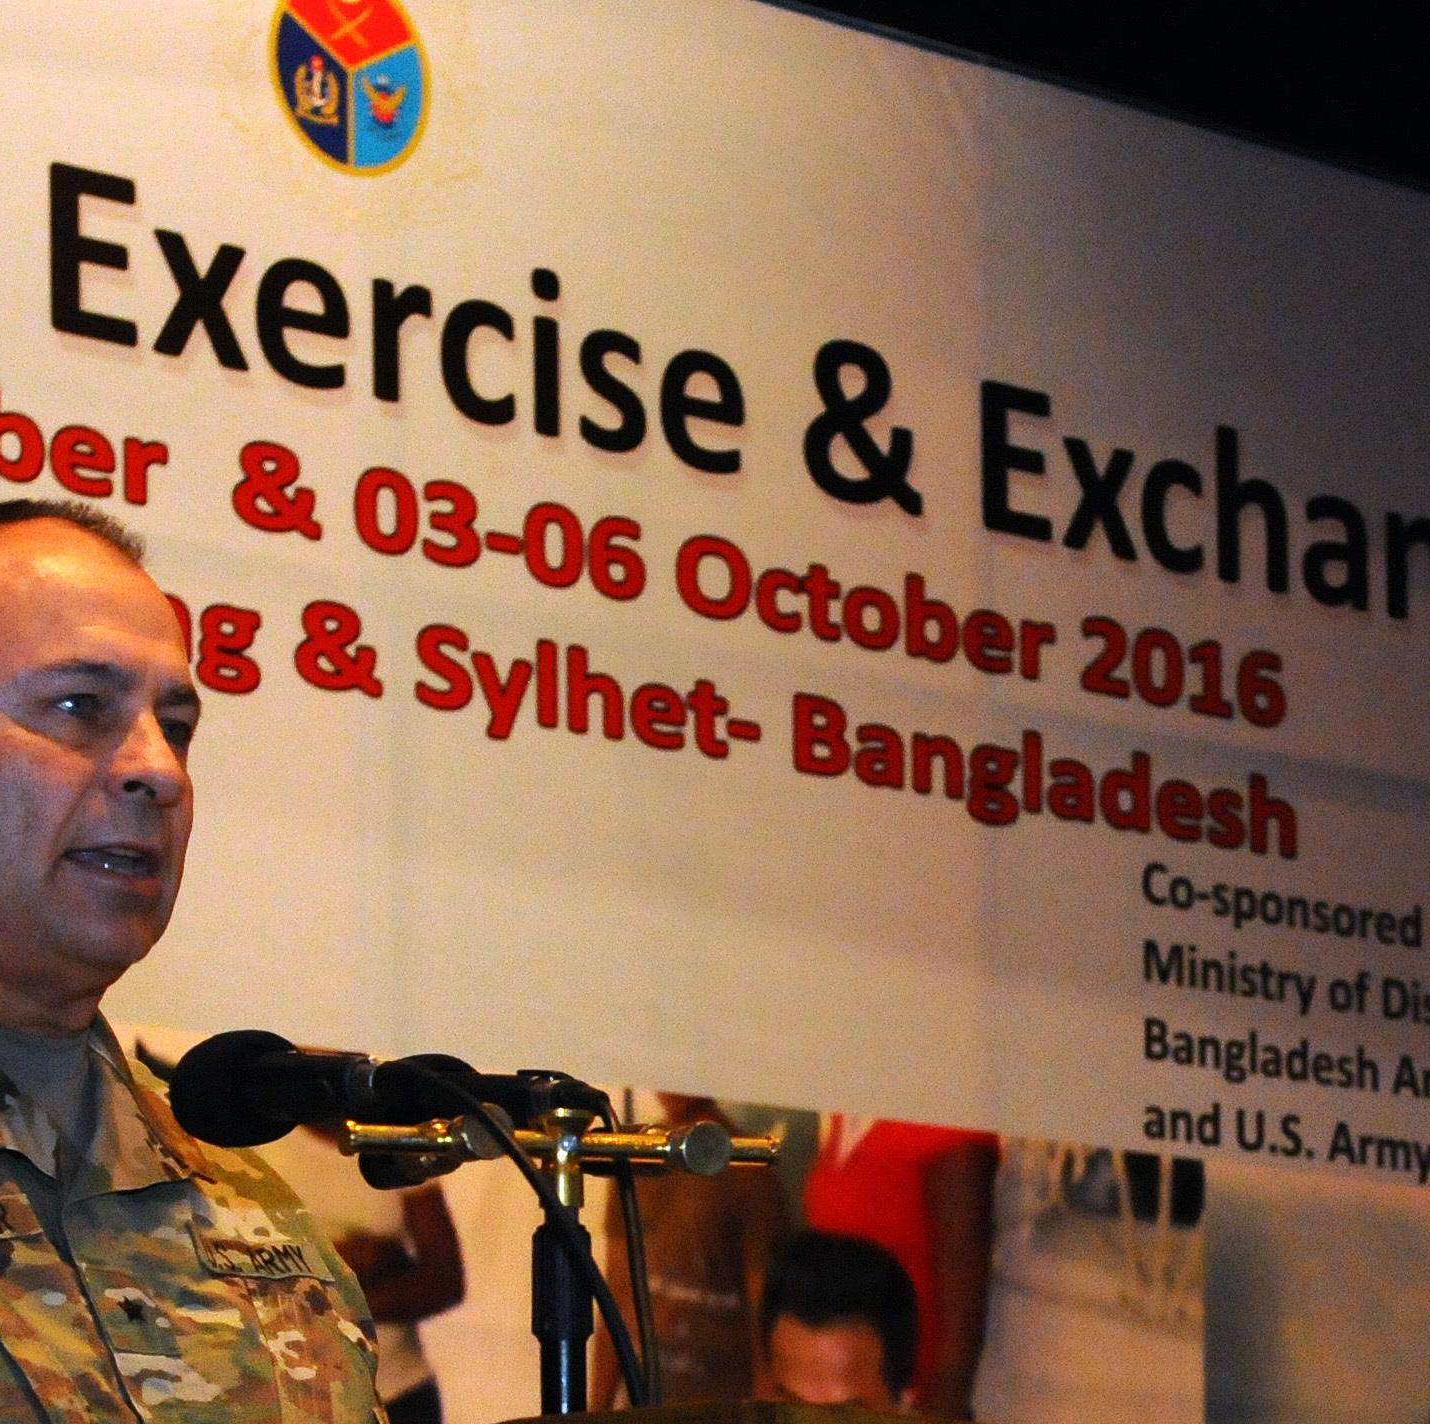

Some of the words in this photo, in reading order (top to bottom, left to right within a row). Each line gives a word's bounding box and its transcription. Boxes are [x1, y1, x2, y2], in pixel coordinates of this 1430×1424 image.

[49, 161, 745, 474] Exercise
[804, 339, 922, 518] &
[232, 440, 321, 541] &
[354, 466, 645, 601] 03-06
[676, 535, 1056, 681] October
[1080, 616, 1287, 728] 2016
[294, 601, 382, 698] &
[415, 624, 761, 759] Sylhet-
[792, 692, 1299, 860] Bangladesh
[1142, 862, 1422, 947] Co-sponsored
[1142, 939, 1317, 1016] Ministry
[1329, 970, 1371, 1014] of
[1144, 1017, 1380, 1092] Bangladesh
[1142, 1103, 1221, 1146] and
[1236, 1108, 1315, 1159] U.S.
[249, 1243, 314, 1275] ARMY
